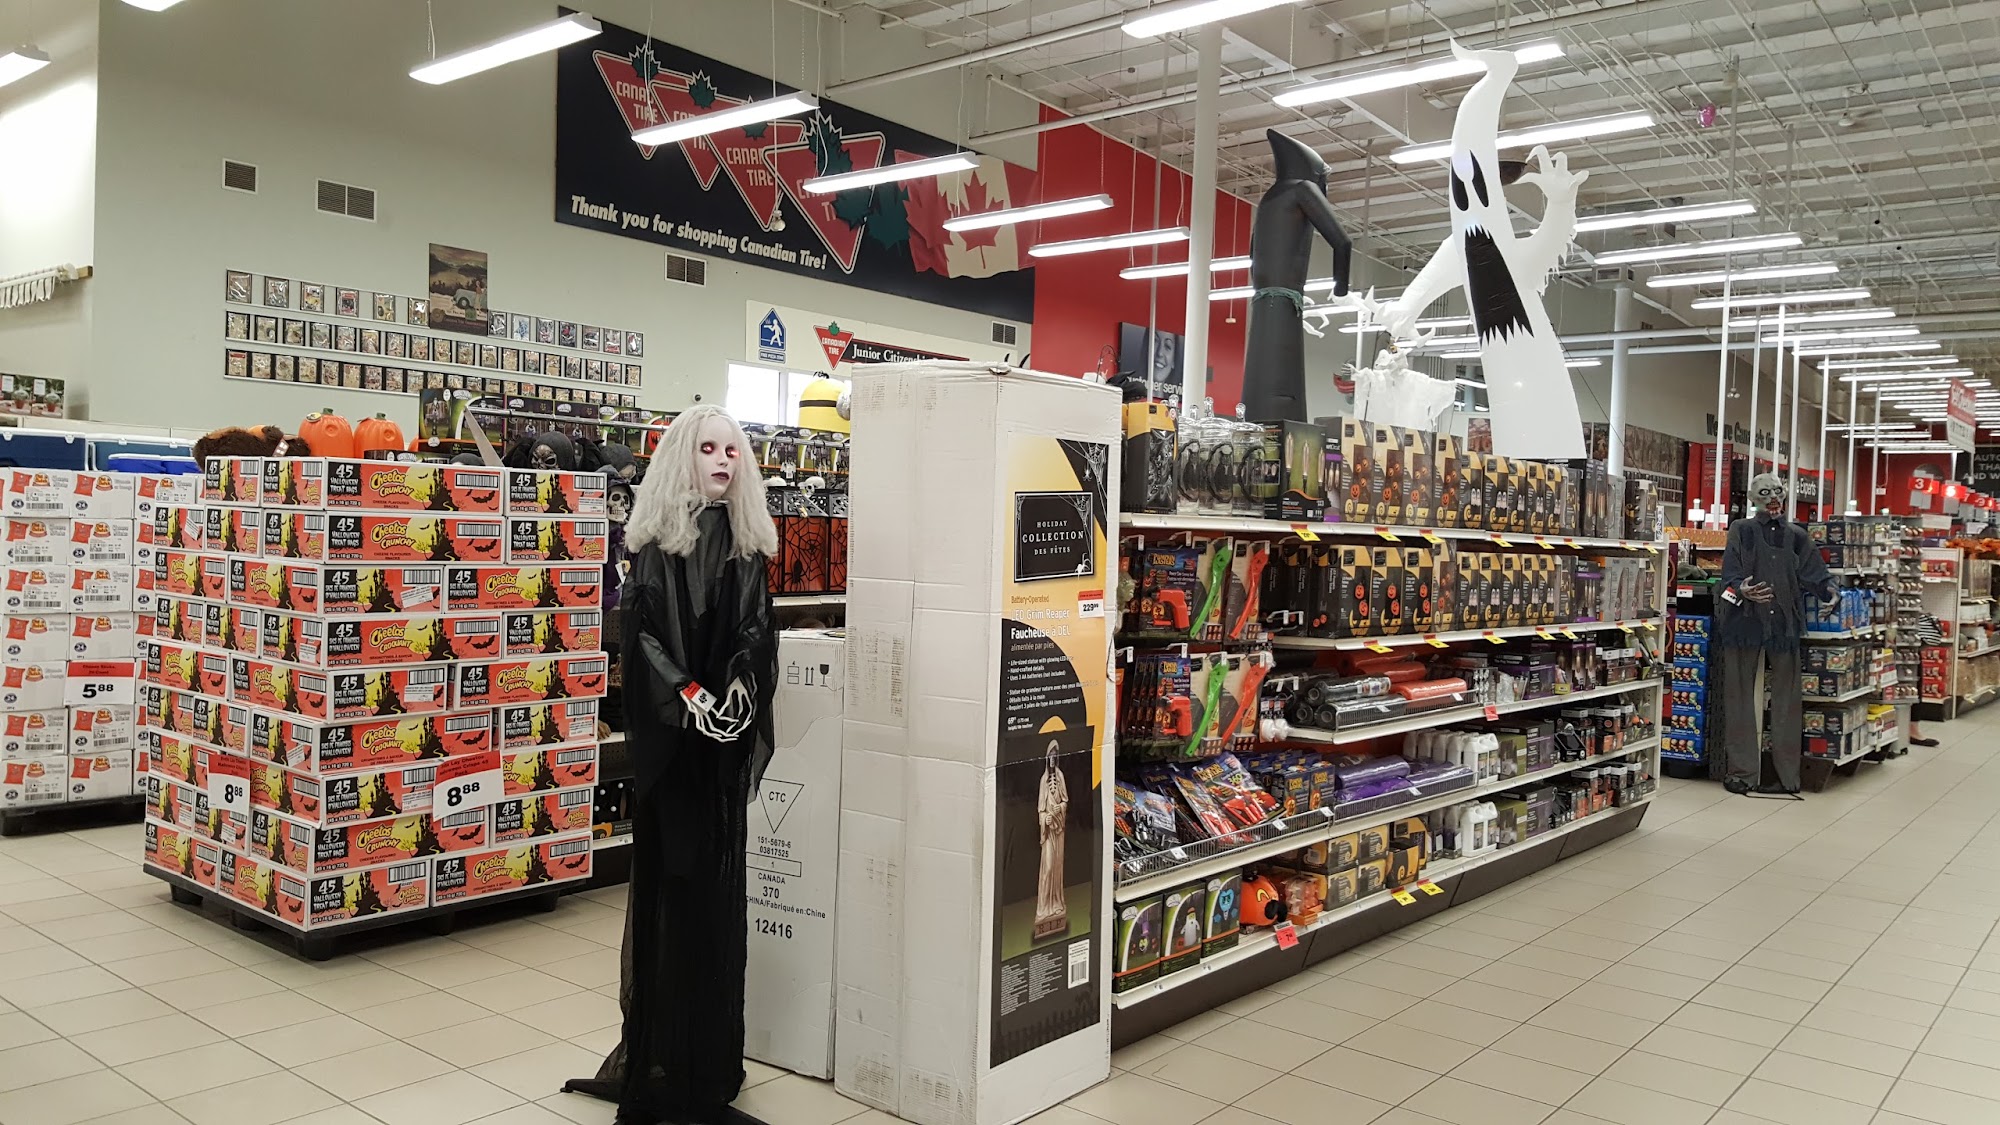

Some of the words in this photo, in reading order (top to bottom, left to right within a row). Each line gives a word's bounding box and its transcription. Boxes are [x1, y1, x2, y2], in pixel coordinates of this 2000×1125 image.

[746, 169, 774, 186] TIRE
[571, 195, 618, 223] Thank
[621, 212, 649, 230] you
[652, 214, 674, 236] for
[676, 221, 738, 254] shopping
[740, 236, 797, 264] Canadian
[799, 250, 827, 270] Tire!
[828, 346, 840, 356] TIRE
[852, 344, 882, 360] Junior
[336, 464, 354, 478] 45
[371, 470, 406, 490] Cheetos
[516, 474, 531, 486] 45
[1914, 478, 1924, 489] 3
[380, 486, 414, 496] CRUNCHY
[337, 517, 355, 531] 45
[518, 522, 532, 534] 45
[372, 522, 407, 542] Cheetos
[1022, 531, 1084, 543] COLLECTION
[381, 537, 416, 549] CRUNCHY
[1050, 545, 1070, 554] FÊTES
[332, 571, 350, 585] 45
[455, 571, 472, 583] 45
[486, 574, 517, 591] Cheetos
[494, 587, 523, 598] CROQUANT
[1011, 595, 1049, 604] Battery-Operated
[1011, 609, 1024, 620] LED
[1027, 609, 1044, 620] Grim
[1046, 608, 1070, 619] Reaper
[513, 617, 527, 630] 45
[336, 624, 353, 637] 45
[371, 625, 404, 646] Cheetos
[1011, 627, 1050, 639] Faucheuse
[380, 640, 412, 653] CROQUANT
[1011, 643, 1034, 651] alimentée
[1044, 641, 1054, 650] piles
[468, 668, 482, 680] 45
[497, 668, 526, 686] Cheetos
[341, 676, 357, 690] 45
[504, 680, 533, 692] CRUNCHY
[511, 710, 525, 722] 45
[327, 728, 345, 742] 45
[362, 726, 396, 748] Cheetos
[371, 741, 402, 755] CROQUANT
[334, 781, 350, 794] 45
[768, 791, 786, 803] CTC
[502, 803, 517, 816] 45
[323, 829, 340, 843] 45
[357, 826, 392, 848] Cheetos
[366, 840, 400, 853] CRUNCHY
[760, 846, 789, 857] 03817525
[443, 860, 459, 874] 45
[474, 856, 506, 878] Cheetos
[482, 868, 511, 883] CROQUANT
[758, 873, 785, 884] CANADA
[319, 880, 336, 894] 45
[762, 886, 779, 899] 370
[755, 918, 792, 939] 12416
